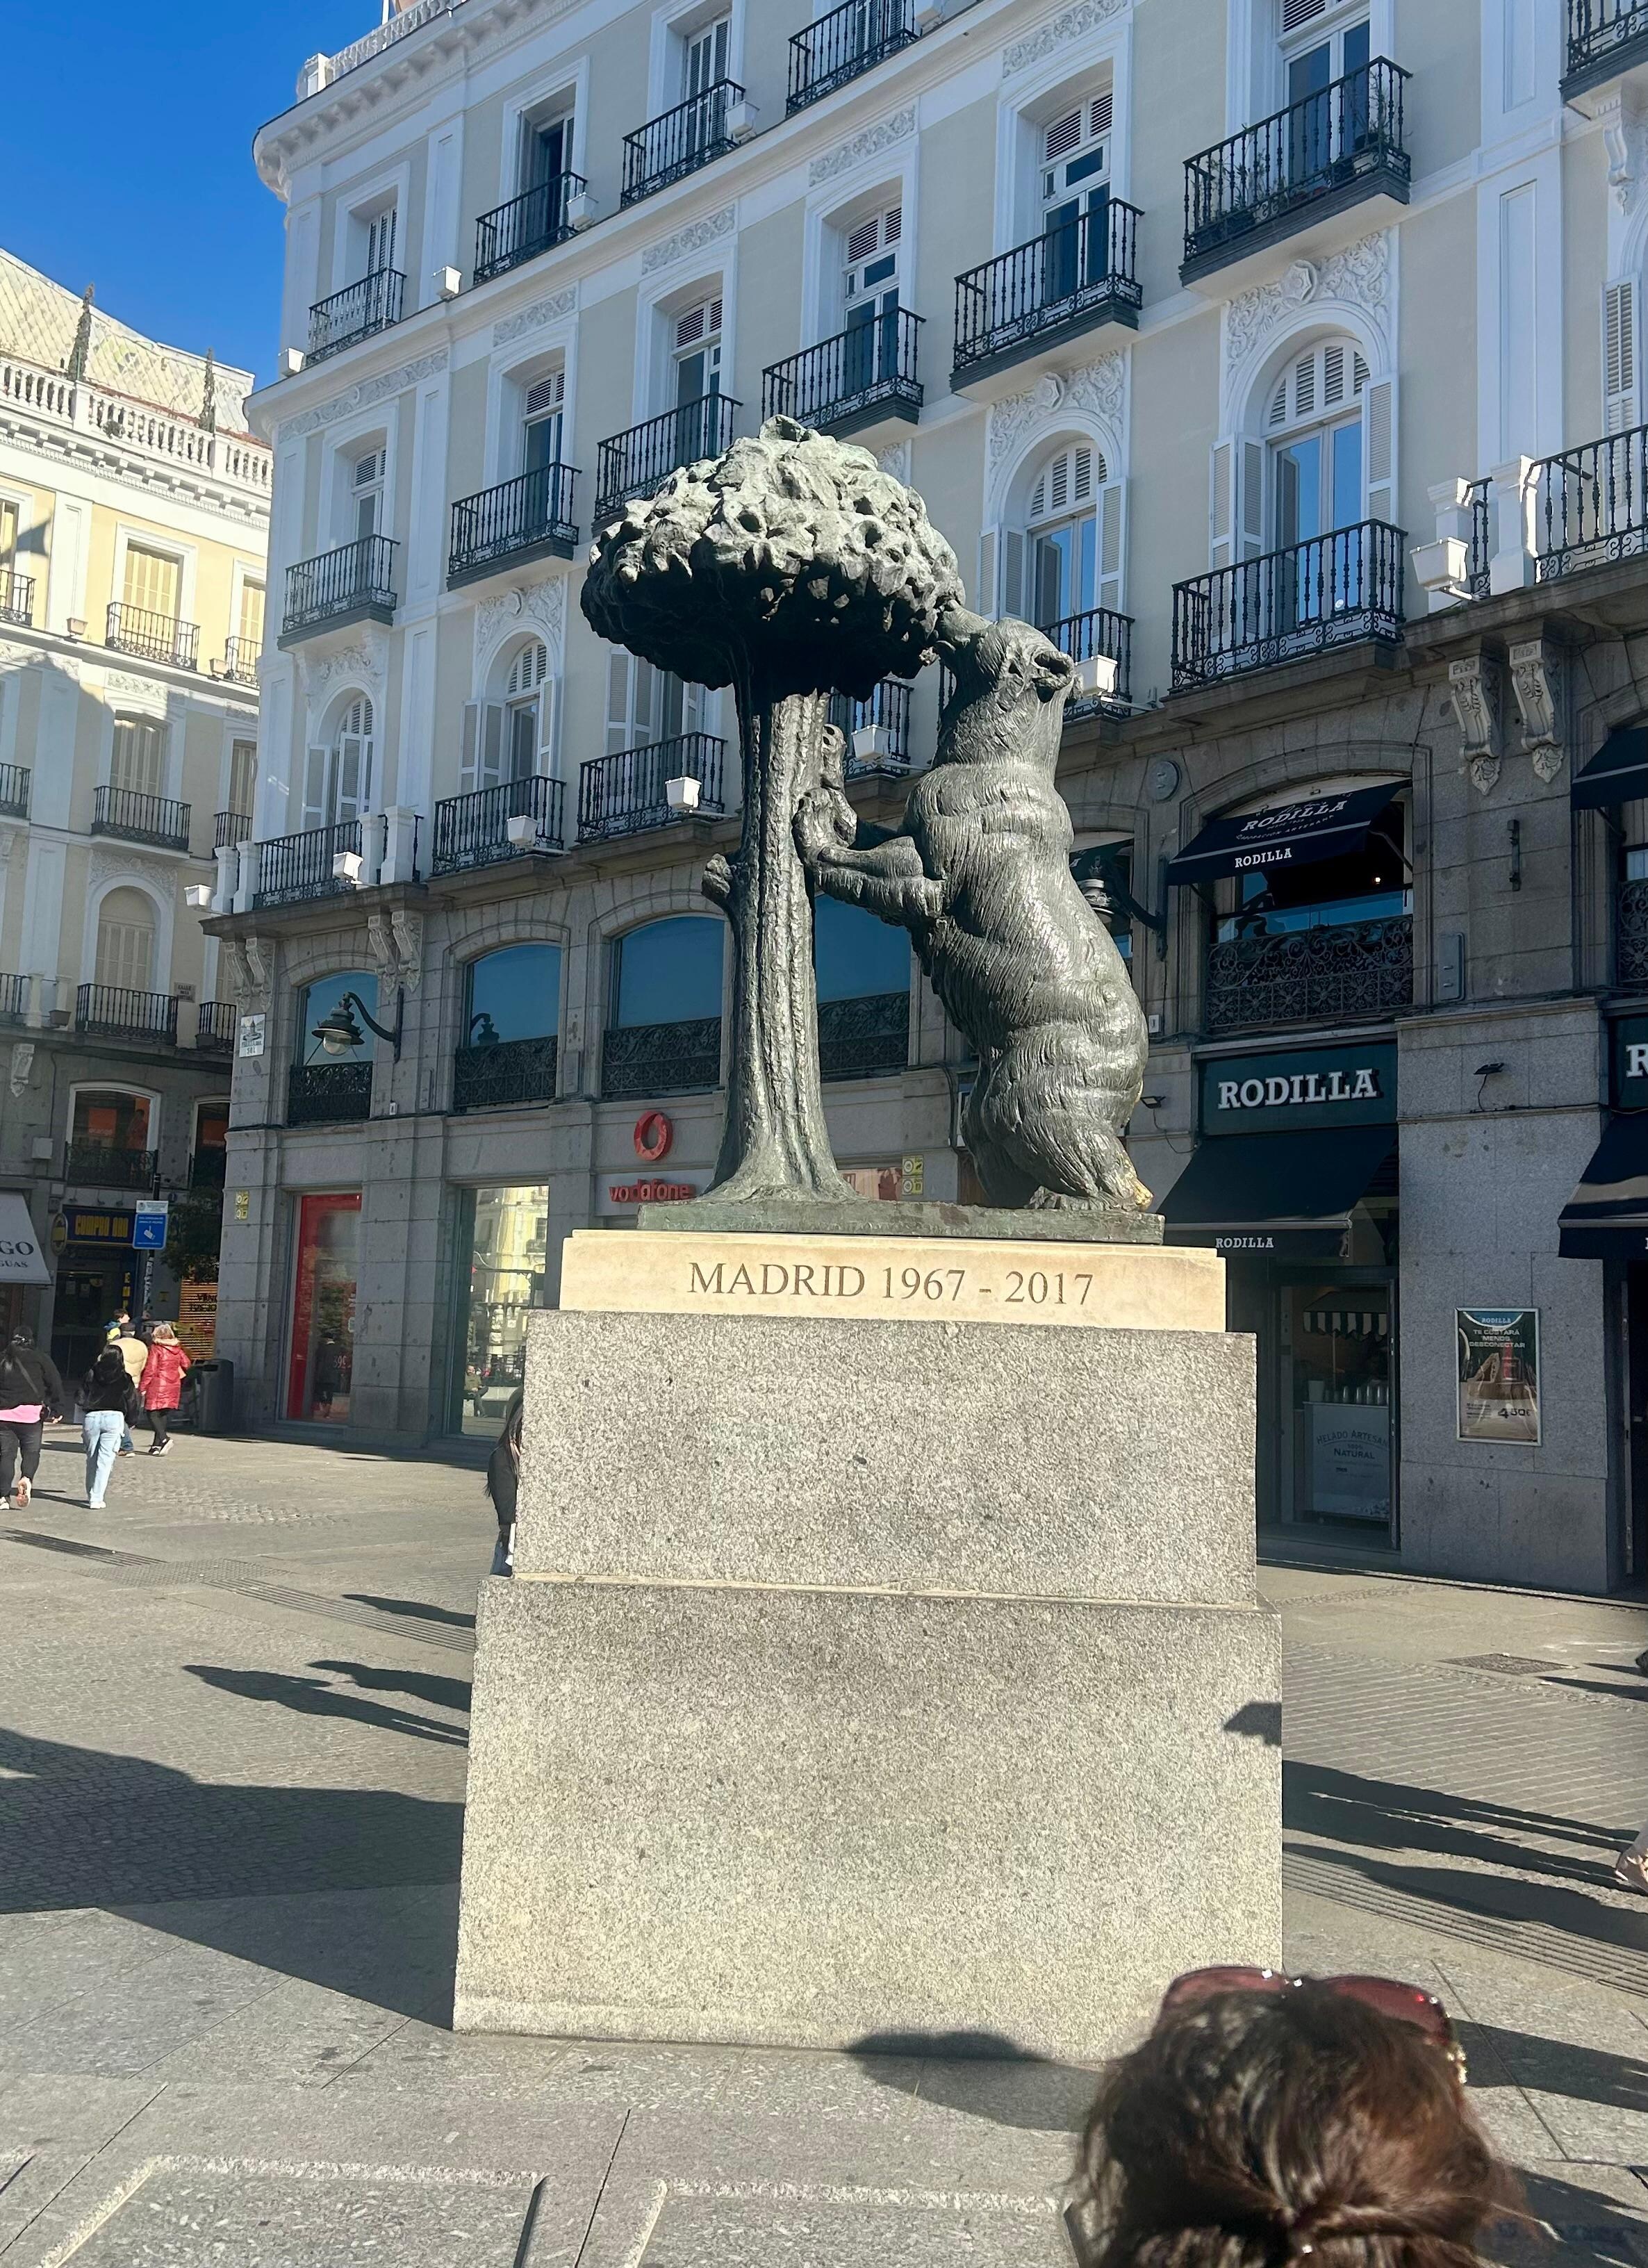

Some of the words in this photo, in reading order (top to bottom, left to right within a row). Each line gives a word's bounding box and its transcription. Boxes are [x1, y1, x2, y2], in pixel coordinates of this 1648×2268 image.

[1241, 800, 1348, 832] RODILLA
[1235, 848, 1292, 868] RODILLA
[1217, 1068, 1377, 1110] RODILLA
[609, 1178, 692, 1203] vodafone
[1215, 1237, 1274, 1249] RODILLA
[686, 1262, 865, 1298] MADRID
[881, 1266, 965, 1302] 1967
[1004, 1270, 1094, 1306] 2017
[1317, 1431, 1349, 1445] HELADO
[1334, 1448, 1376, 1460] NATURAL
